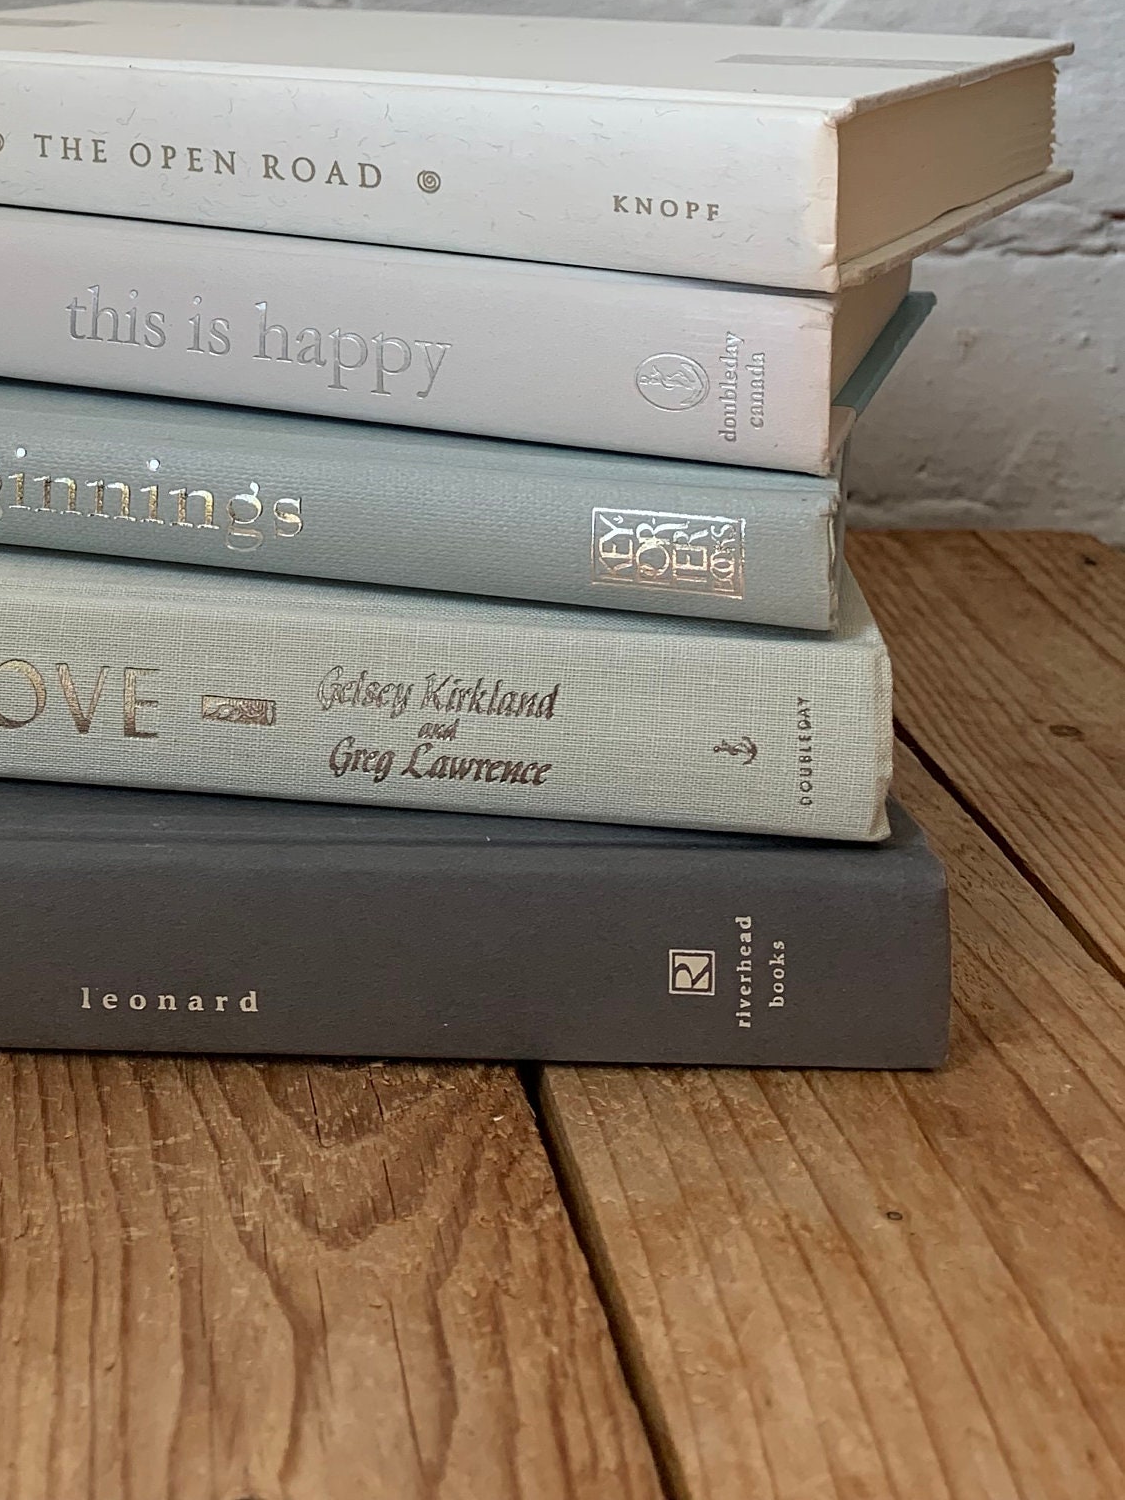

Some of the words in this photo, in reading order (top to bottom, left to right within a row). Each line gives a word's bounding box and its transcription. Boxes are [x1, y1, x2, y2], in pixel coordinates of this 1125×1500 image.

[34, 133, 108, 164] THE
[129, 142, 238, 176] OPEN
[261, 154, 383, 190] ROAD
[612, 195, 720, 222] KNOPF
[65, 285, 166, 348] this
[186, 296, 231, 357] is
[252, 301, 453, 399] happy
[718, 331, 745, 442] doubleday
[746, 352, 765, 430] canada
[317, 665, 414, 720] Gelsey
[421, 672, 561, 720] Kirkland
[329, 735, 395, 783] Greg
[402, 742, 552, 785] Lawrence
[418, 719, 460, 741] and
[797, 696, 812, 806] DOUBLEDAY
[81, 987, 258, 1013] leonard
[735, 915, 752, 1028] riverhead
[769, 940, 785, 1008] books
